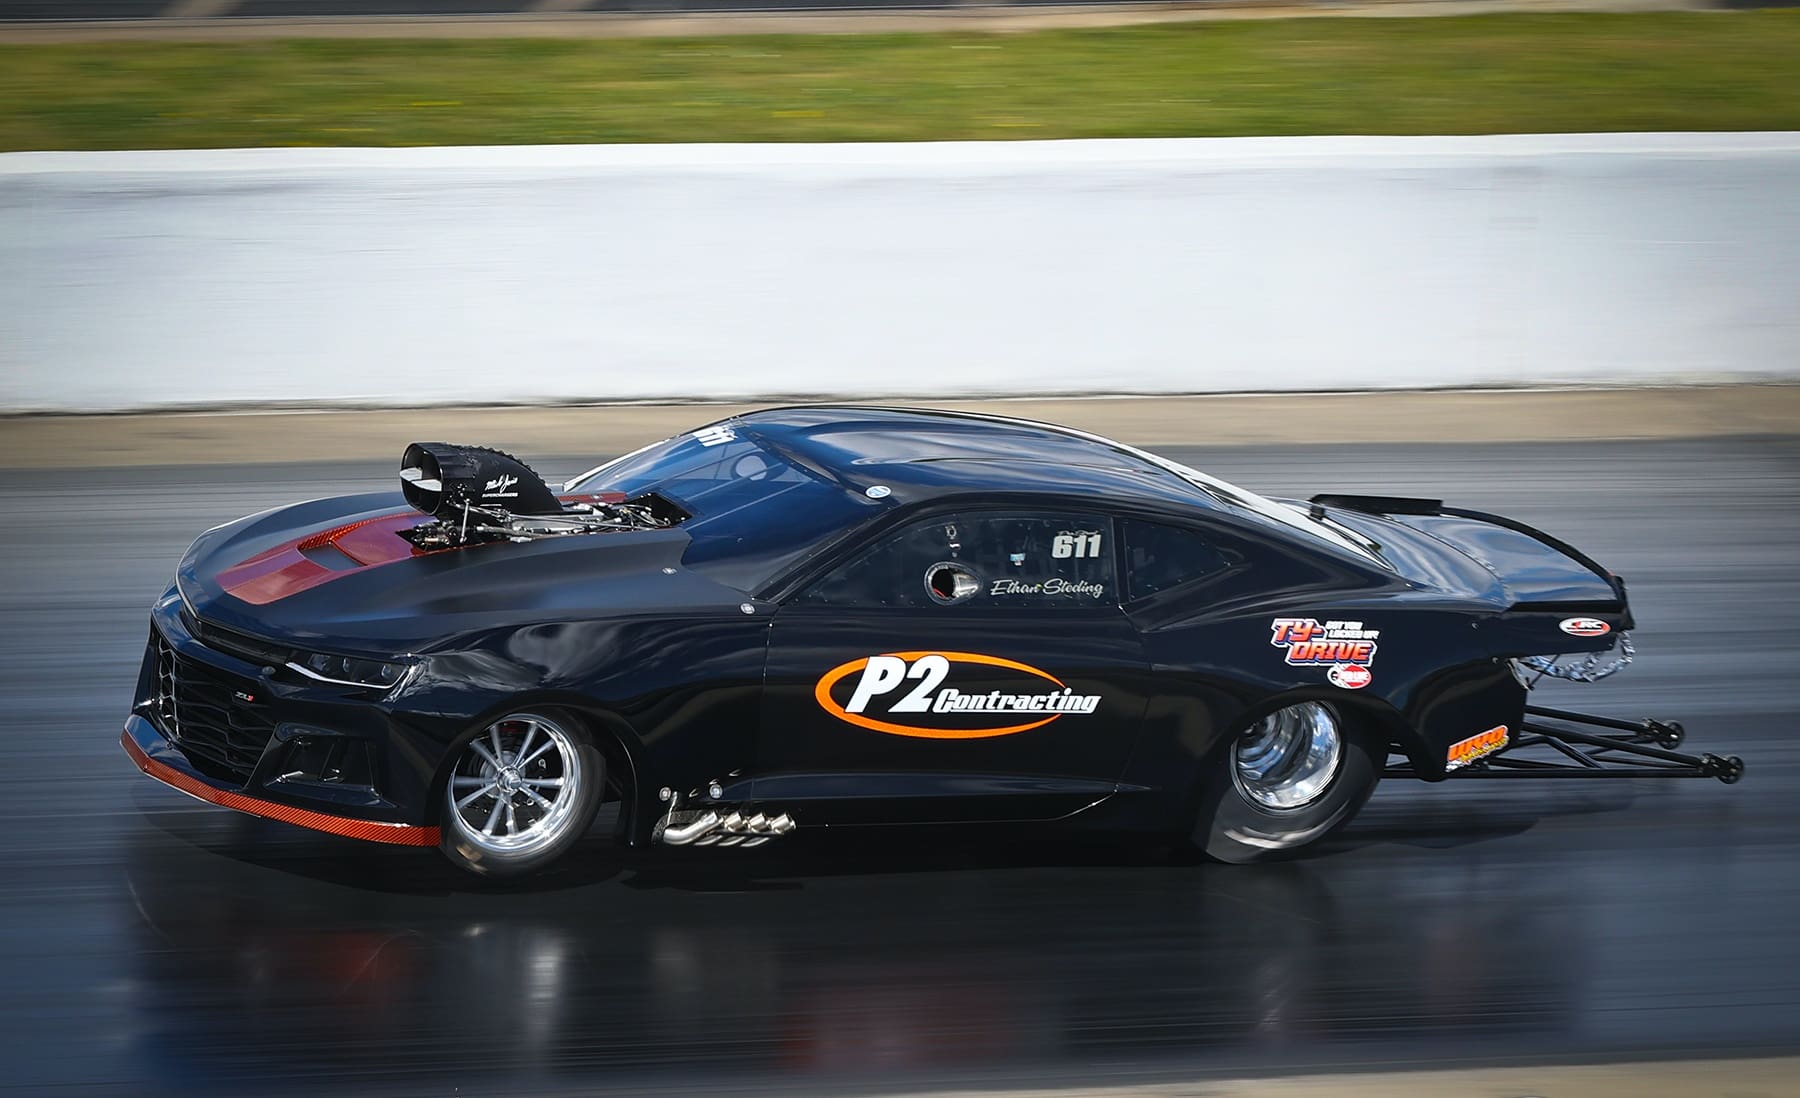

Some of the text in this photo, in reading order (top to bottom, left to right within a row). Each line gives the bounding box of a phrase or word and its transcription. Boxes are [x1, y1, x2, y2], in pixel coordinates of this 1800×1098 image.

[1051, 534, 1101, 559] 611
[990, 578, 1104, 599] Ethan Steding
[1273, 620, 1325, 644] TY-
[1328, 630, 1363, 639] LOCKED
[1288, 641, 1374, 664] DRIVE
[844, 654, 1102, 714] P2 Contracting
